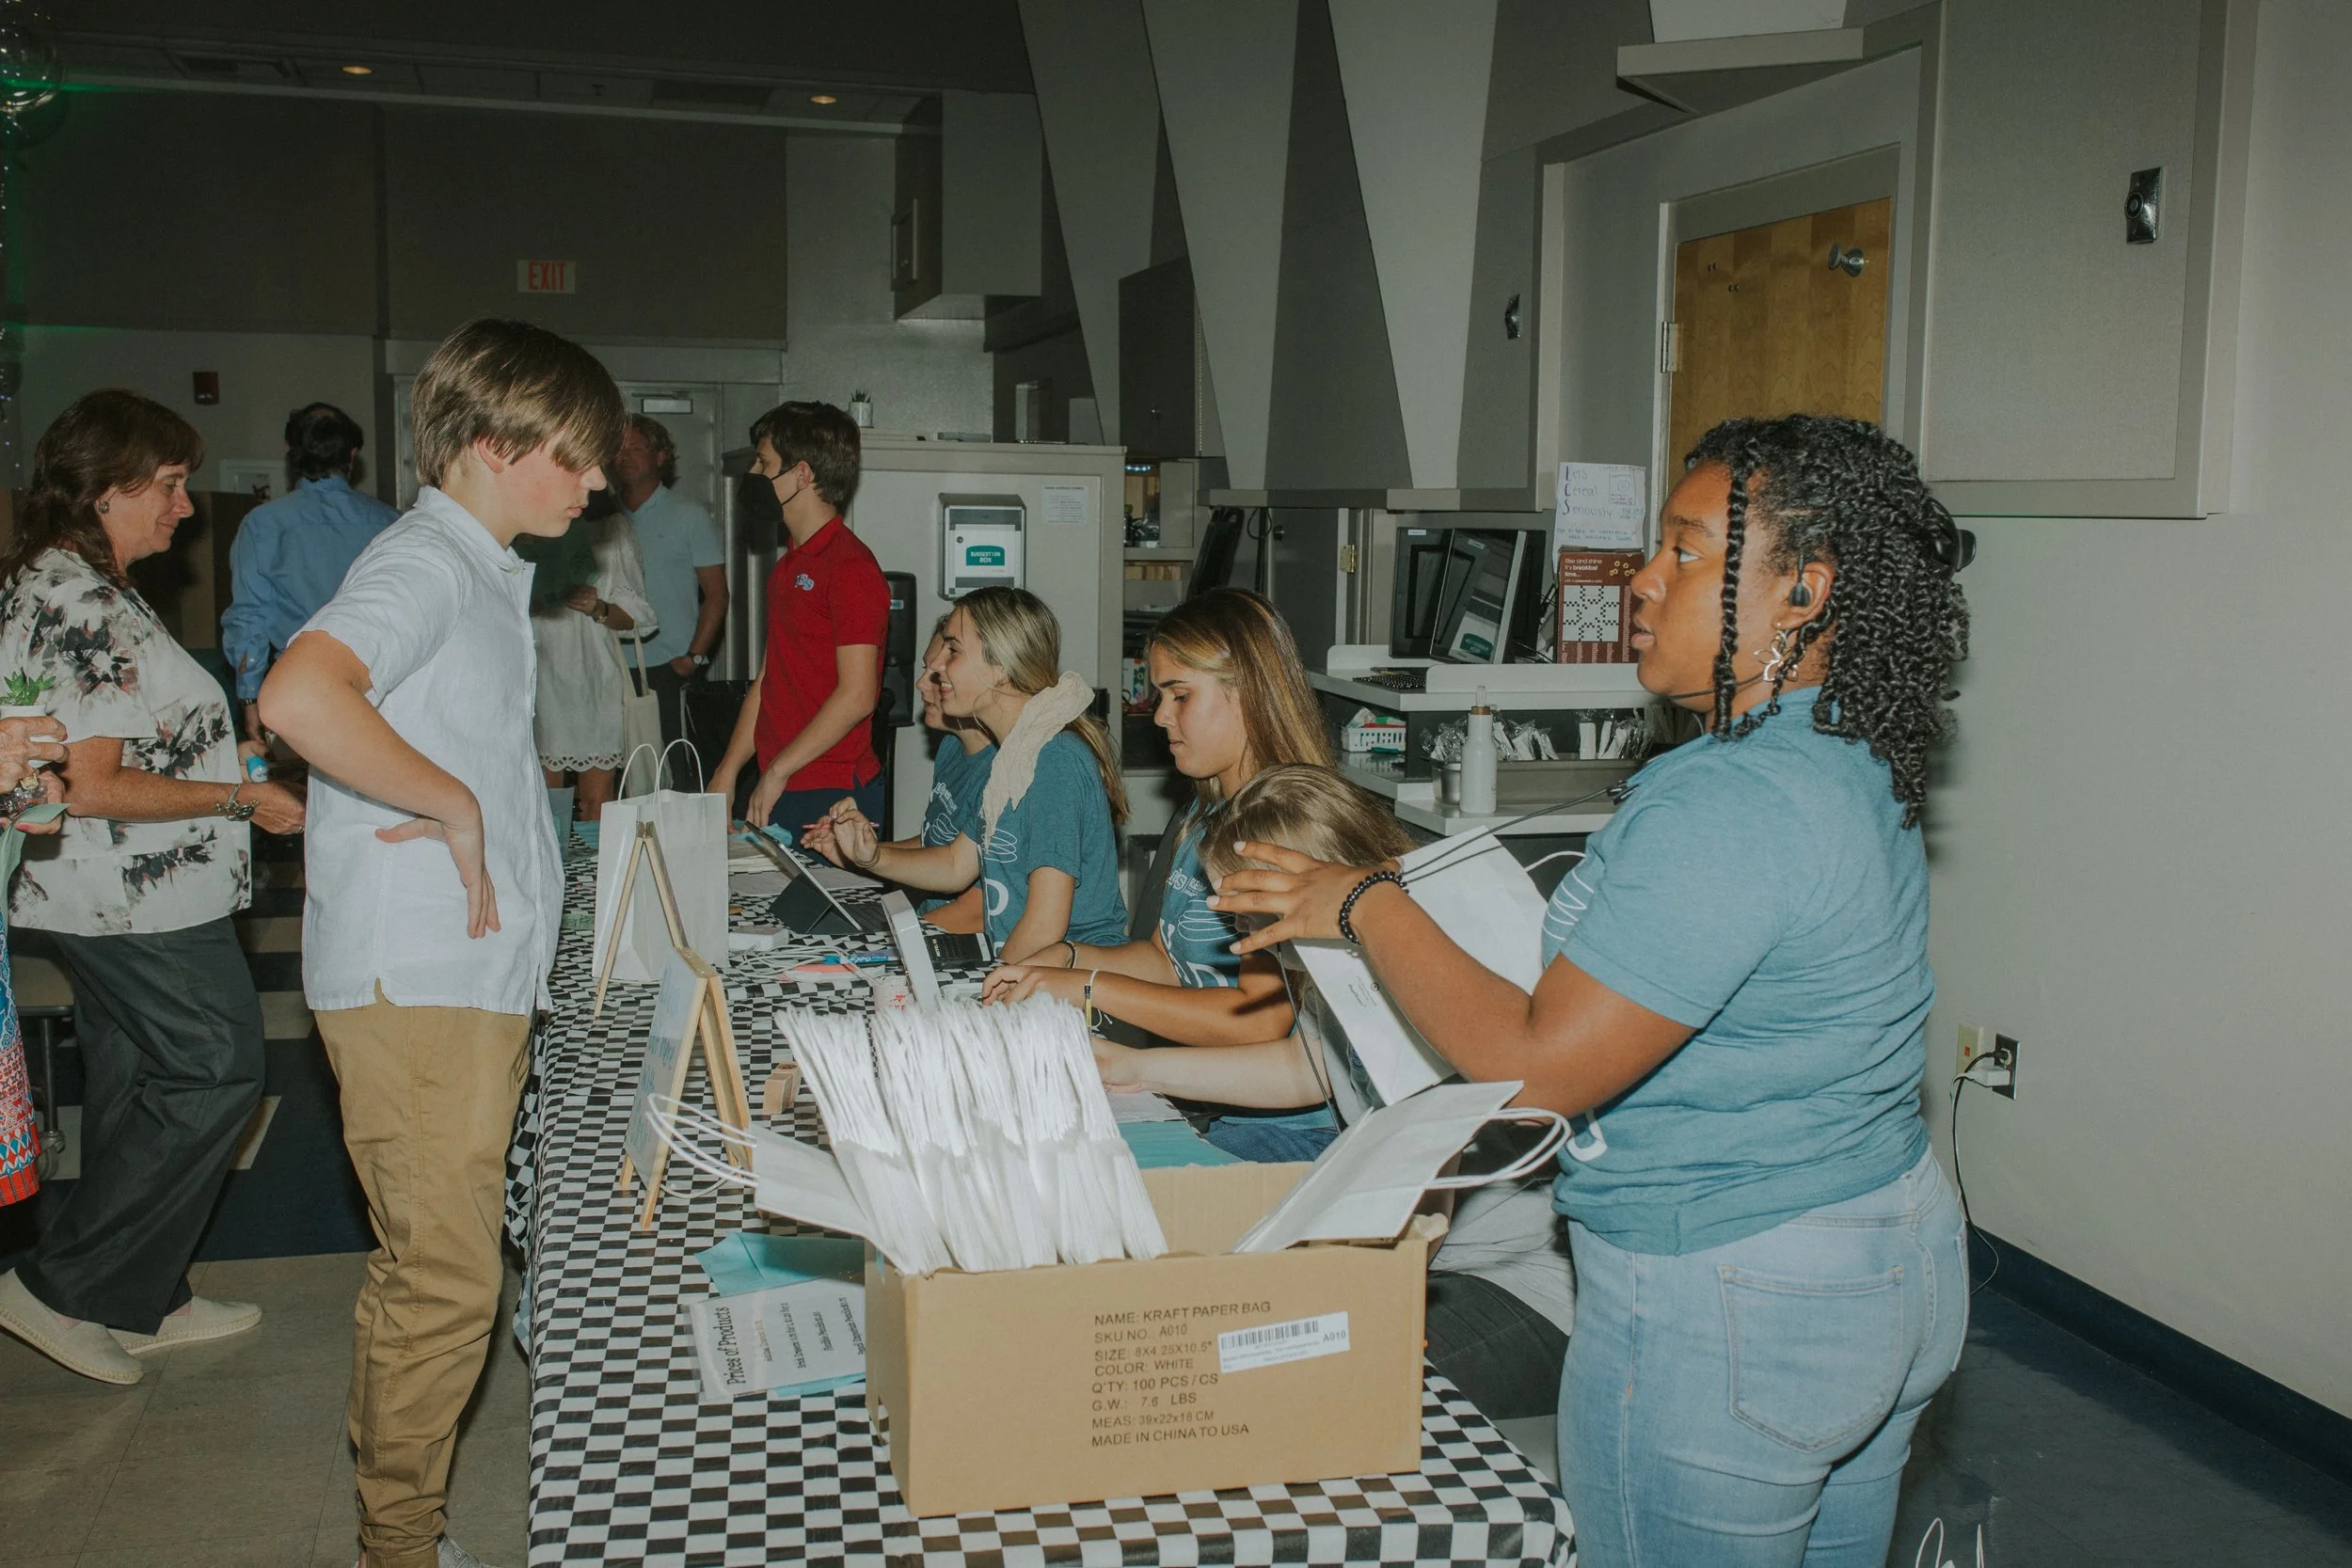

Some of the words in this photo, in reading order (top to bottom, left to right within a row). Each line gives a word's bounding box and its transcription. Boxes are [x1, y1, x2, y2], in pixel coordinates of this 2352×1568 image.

[528, 261, 566, 291] EXIT
[1563, 499, 1613, 520] Seriously
[1094, 1312, 1139, 1326] NAME:
[1143, 1307, 1189, 1322] KRAFT
[1192, 1304, 1239, 1318] PAPER
[1242, 1301, 1271, 1314] BAG
[712, 1307, 737, 1347] Products
[1094, 1331, 1123, 1344] SKU
[1159, 1323, 1187, 1338] A010
[1323, 1330, 1346, 1343] A010
[717, 1347, 739, 1355] of
[723, 1357, 746, 1386] Prices
[1094, 1361, 1148, 1377] COLOR:
[1153, 1358, 1194, 1370] WHITE
[1091, 1380, 1128, 1393] Q'TY:
[1134, 1378, 1156, 1391] 100
[1160, 1375, 1189, 1388] PCS
[1199, 1372, 1218, 1386] CS
[1141, 1396, 1159, 1408] 7.6
[1170, 1392, 1197, 1405] LBS
[1092, 1415, 1136, 1429] MEAS:
[1138, 1411, 1192, 1426] 39x22x18
[1196, 1410, 1214, 1421] CM
[1091, 1432, 1132, 1448] MADE
[1136, 1431, 1150, 1443] IN
[1152, 1427, 1198, 1442] CHINA
[1199, 1425, 1217, 1438] TO
[1221, 1423, 1249, 1436] USA
